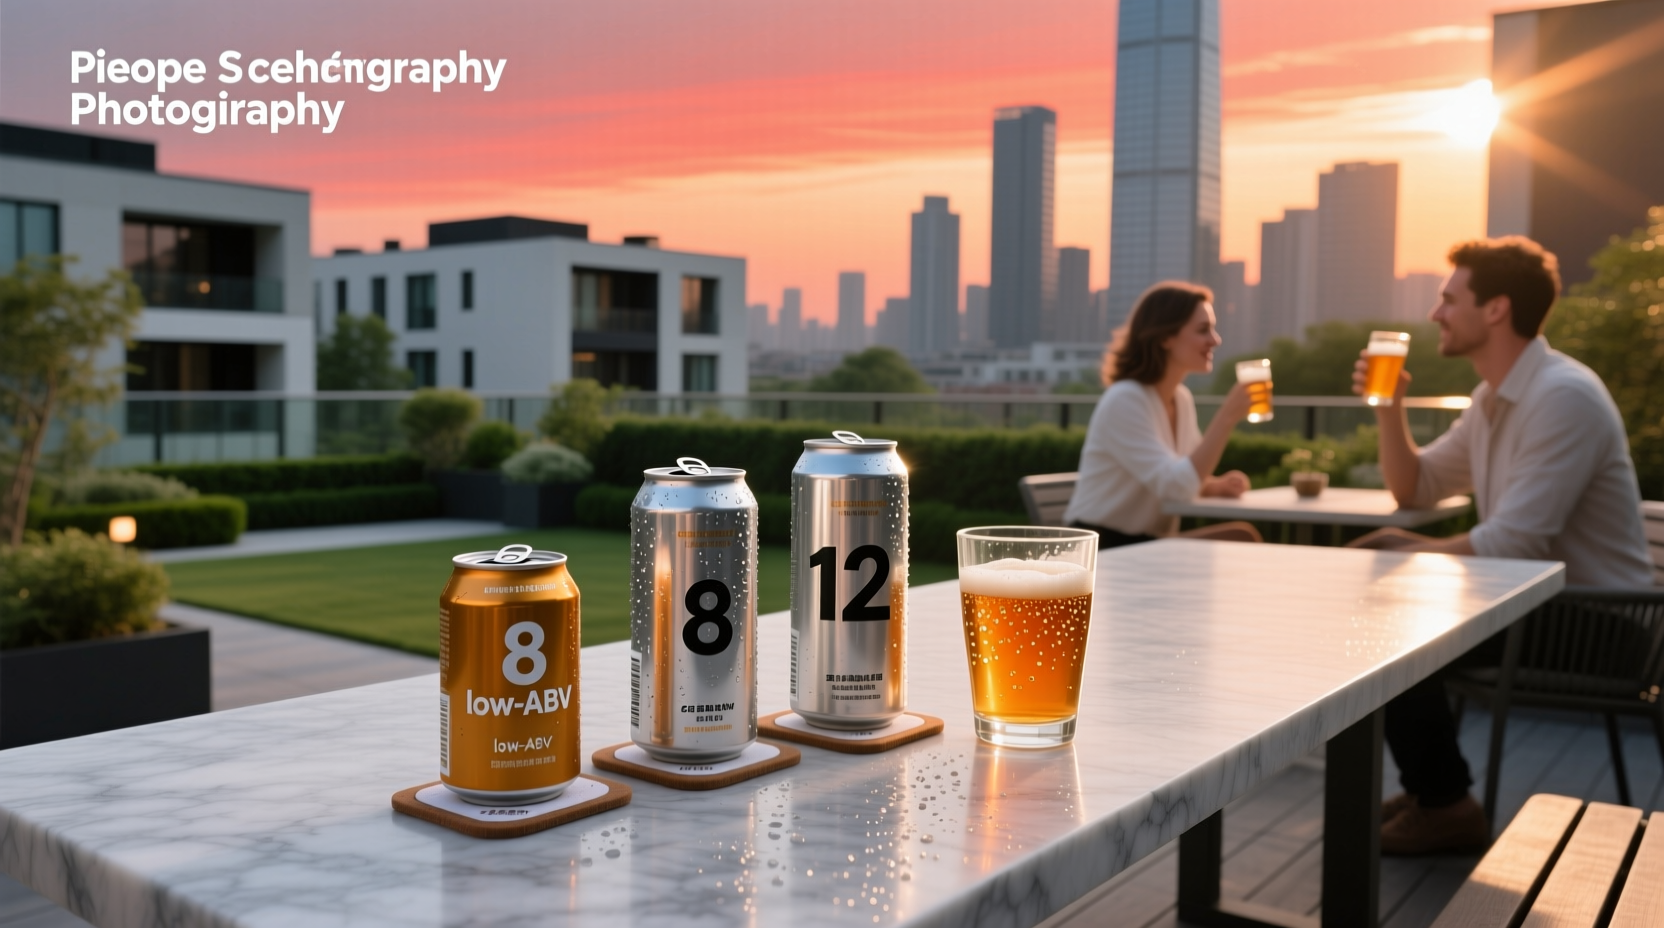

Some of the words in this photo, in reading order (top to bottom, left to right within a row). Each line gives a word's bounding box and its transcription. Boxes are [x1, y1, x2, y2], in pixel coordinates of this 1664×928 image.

[682, 578, 733, 656] 8
[809, 544, 891, 622] 12
[502, 620, 547, 686] 8
[466, 684, 573, 717] low-ABV
